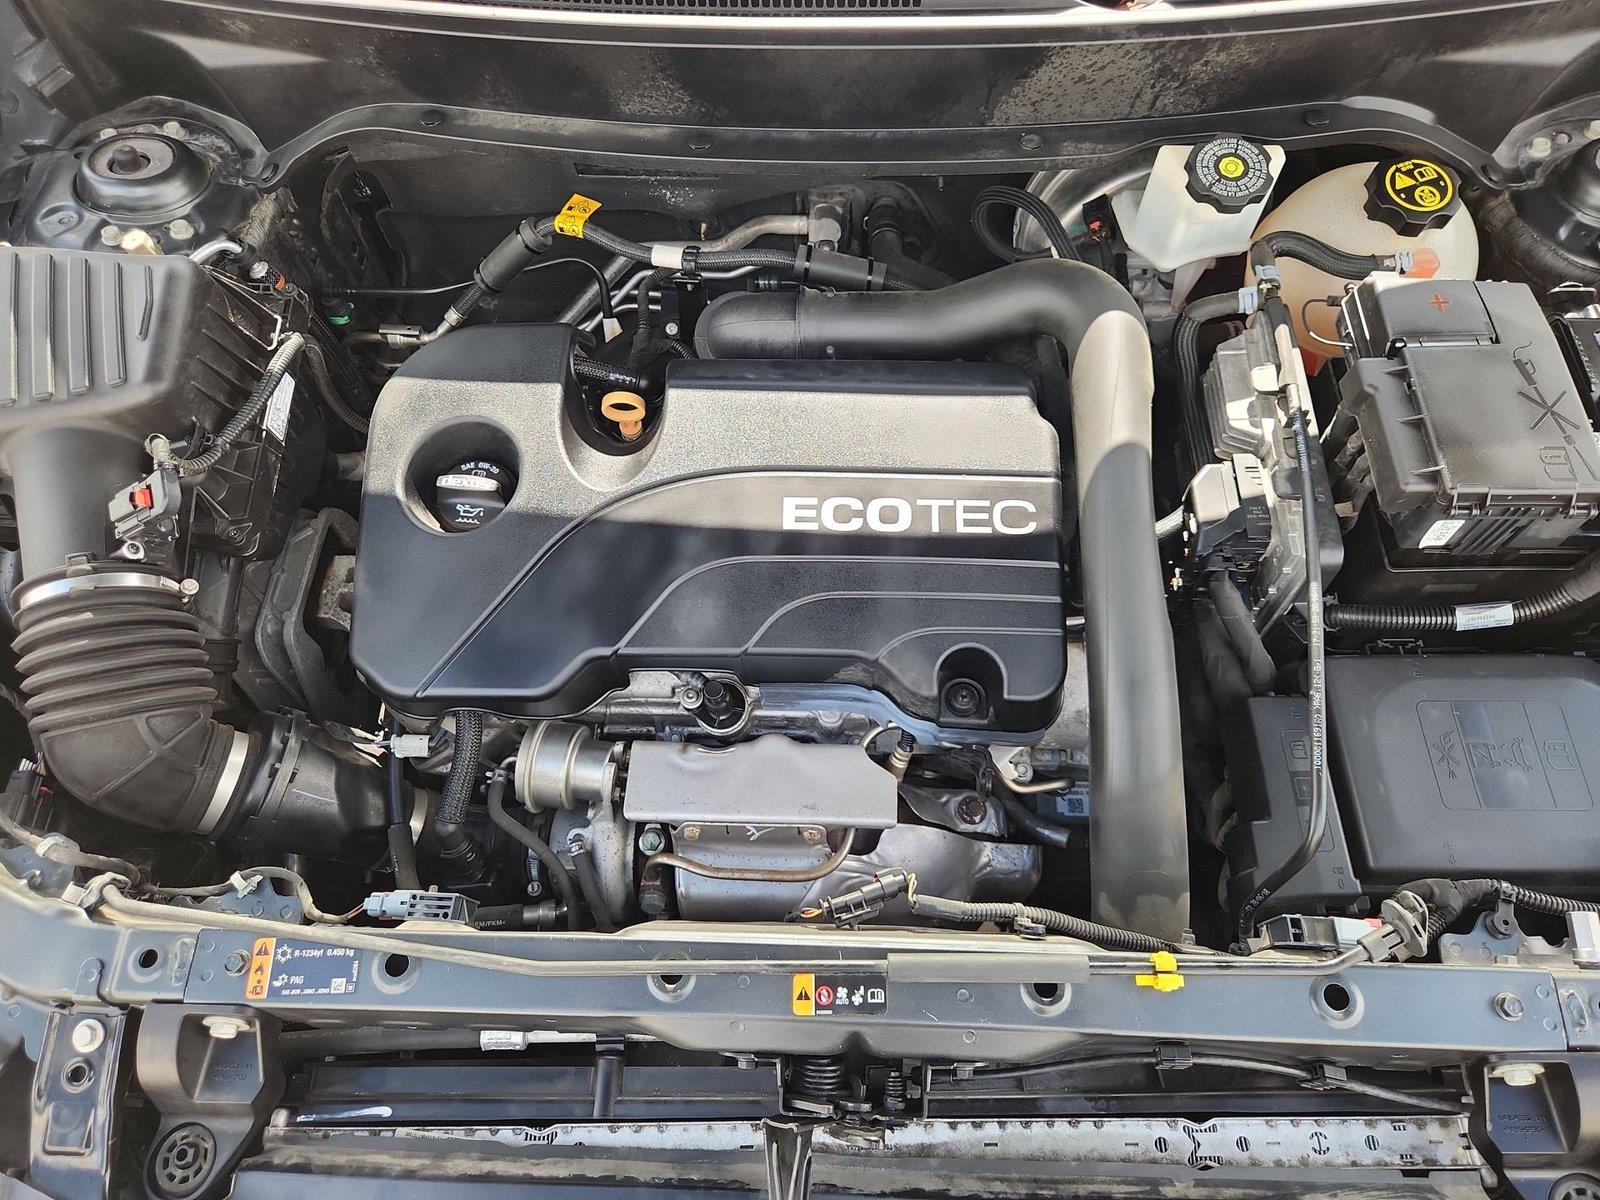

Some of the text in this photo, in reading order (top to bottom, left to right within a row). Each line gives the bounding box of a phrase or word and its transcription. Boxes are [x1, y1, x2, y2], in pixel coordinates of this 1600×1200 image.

[461, 462, 475, 471] SAE
[782, 497, 1037, 535] ECOTEC
[294, 949, 324, 958] R-1234yf
[346, 949, 355, 957] kg
[289, 975, 305, 984] PAG
